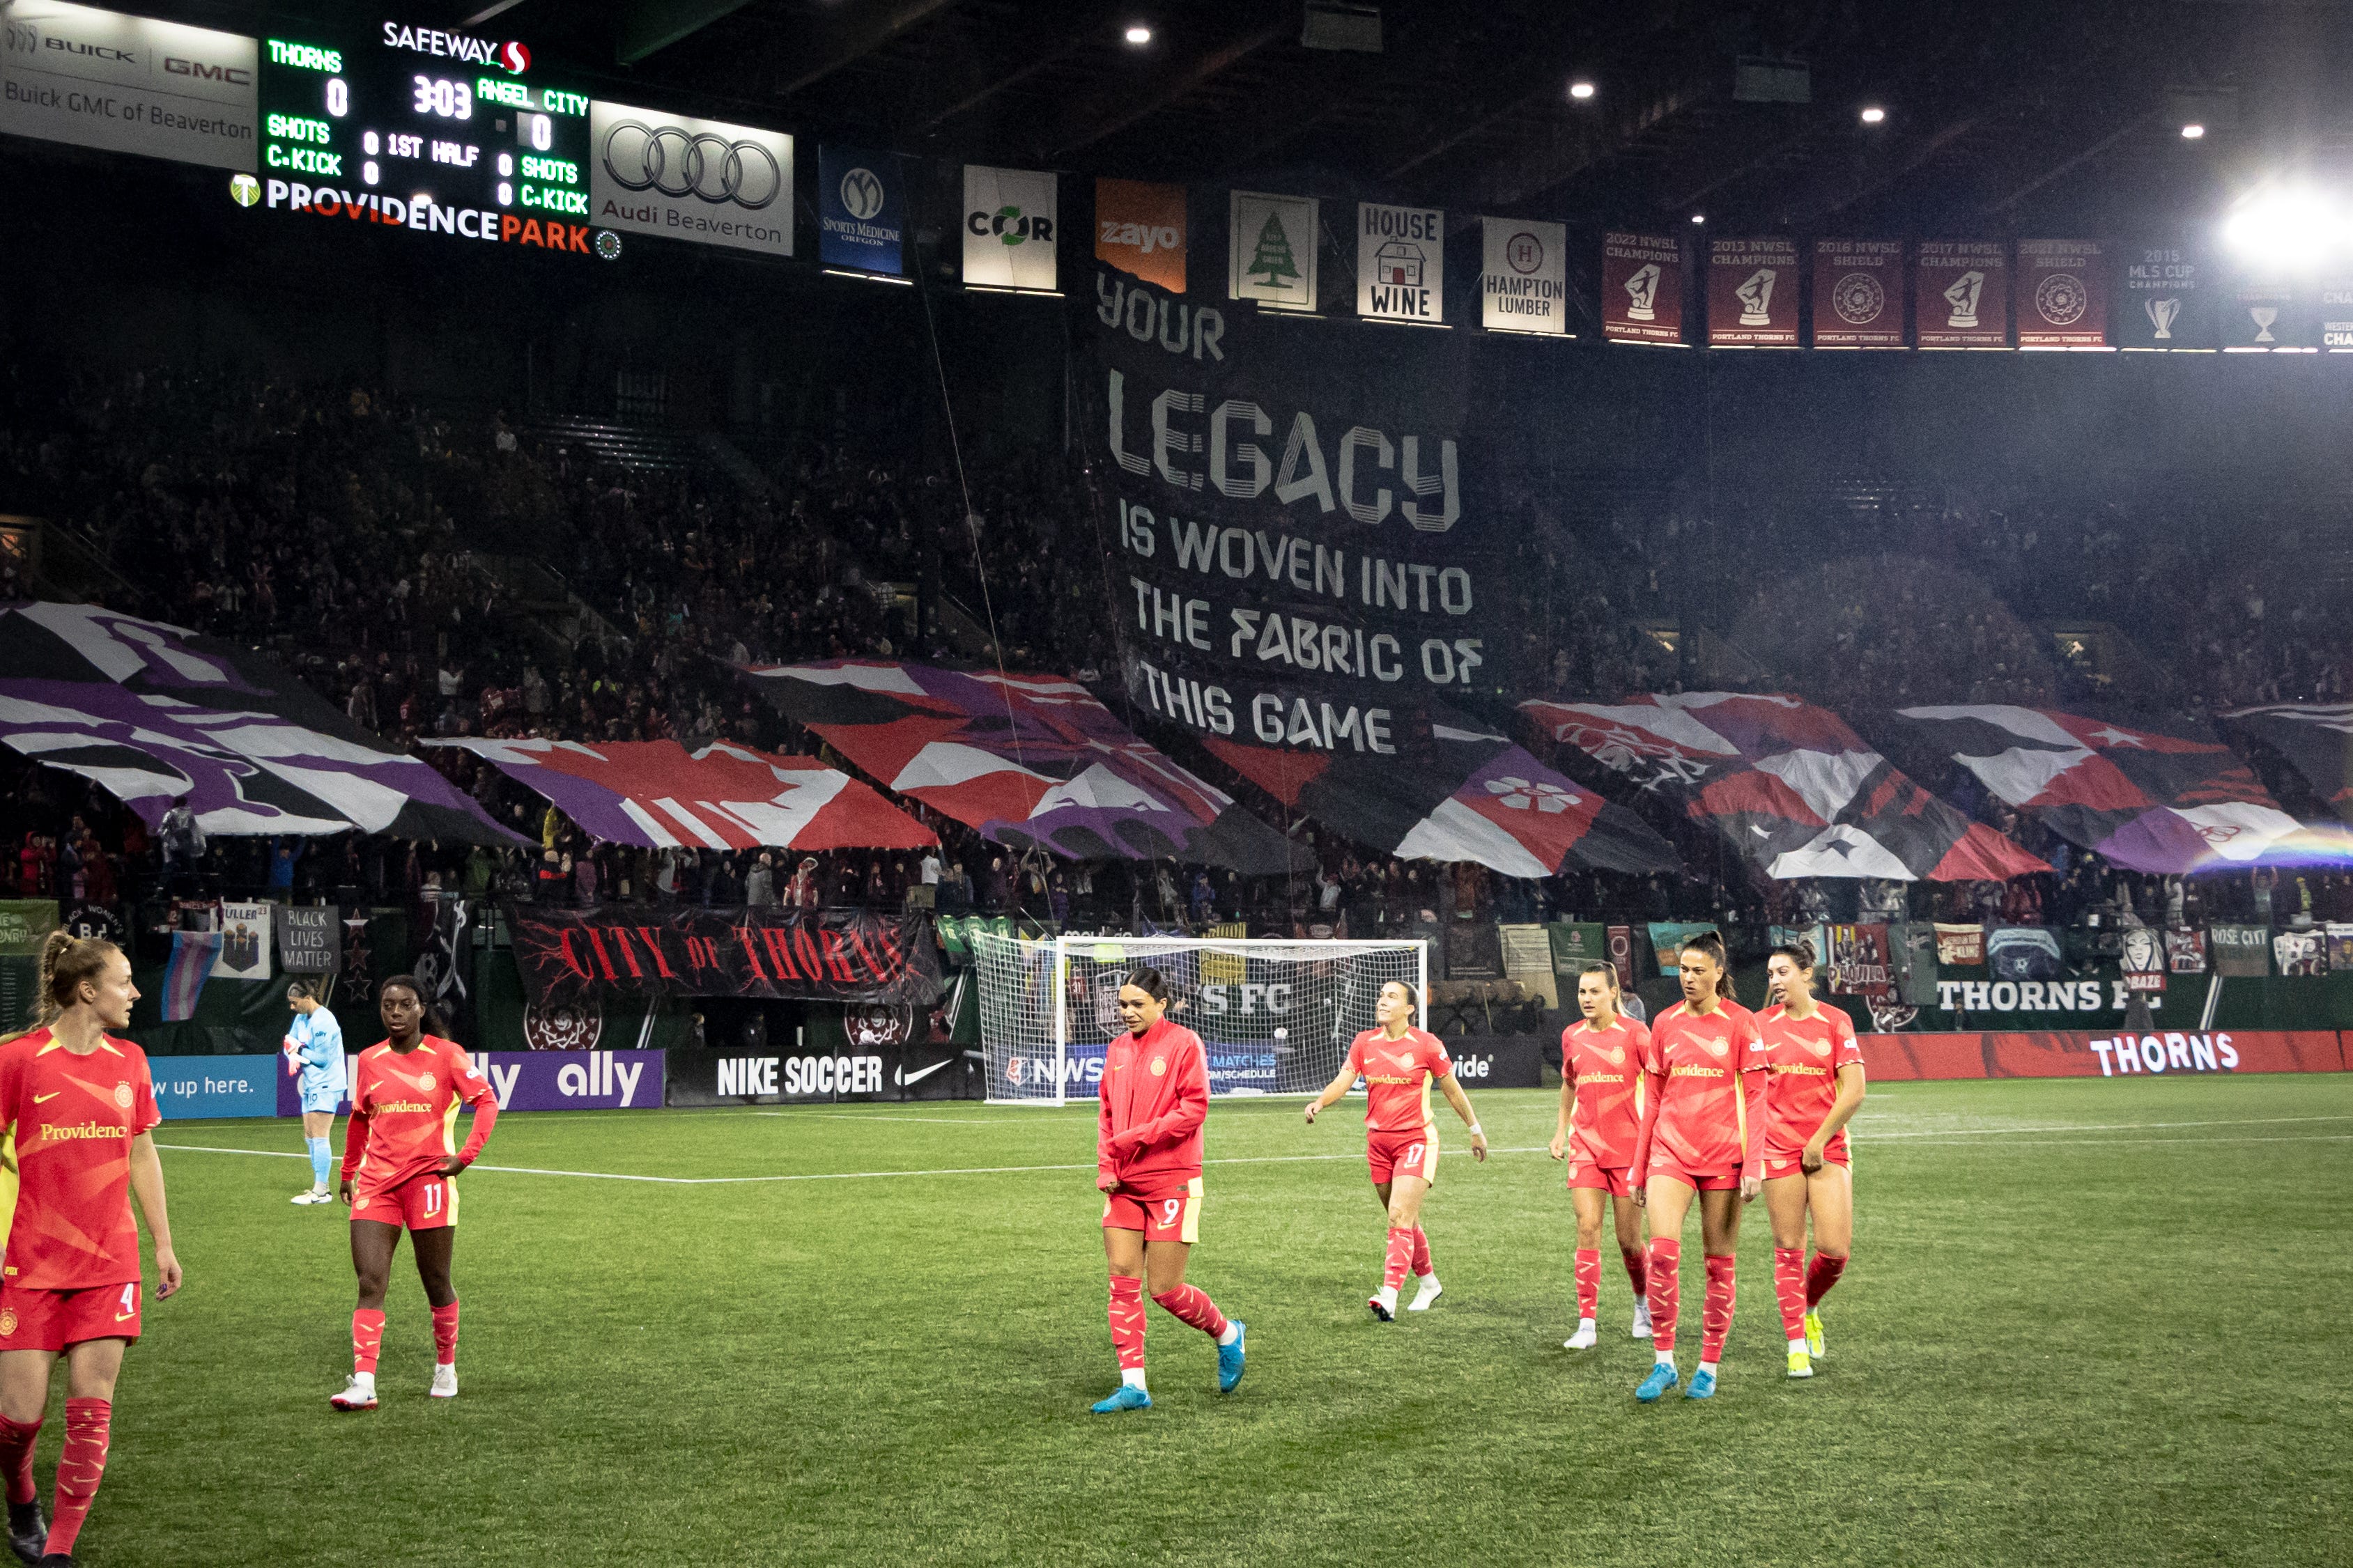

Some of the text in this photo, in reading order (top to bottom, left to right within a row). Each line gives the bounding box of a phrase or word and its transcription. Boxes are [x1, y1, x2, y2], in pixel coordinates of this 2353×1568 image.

[45, 37, 136, 63] BUICK
[384, 22, 497, 63] SAFEWAY
[268, 40, 341, 72] THORNS
[164, 57, 250, 86] GMC
[6, 81, 252, 139] Buick GMC of Beaverton
[327, 79, 348, 116] 0
[414, 75, 472, 120] 3:03
[477, 79, 589, 116] ANGEL CITY
[268, 114, 330, 143] SHOTS
[532, 114, 551, 150] 0
[387, 133, 479, 166] 1ST HALF
[364, 162, 379, 184] 0
[498, 154, 578, 184] 0 SHOTS
[498, 183, 513, 206] 0
[268, 179, 498, 241] PROVIDENCE
[502, 215, 591, 254] PARK
[602, 200, 781, 244] Audi Beaverton
[823, 217, 901, 242] SPORTS MEDICINE
[967, 205, 1053, 246] COR
[1365, 208, 1437, 242] HOUSE
[841, 234, 884, 247] OREGON
[1101, 221, 1180, 254] zayo
[1640, 235, 1679, 250] NWSL
[1750, 241, 1795, 252] NWSL
[1856, 242, 1900, 254] NWSL
[1958, 244, 2002, 255] NWSL
[2058, 244, 2101, 255] NWSL
[1518, 244, 1532, 263] H
[1606, 247, 1679, 263] CHAMPIONS
[1711, 255, 1796, 265] CHAMPIONS
[1833, 256, 1883, 266] SHIELD
[1920, 257, 2003, 267] CHAMPIONS
[2035, 258, 2086, 267] SHIELD
[2129, 265, 2195, 278] MLS CUP
[1486, 275, 1563, 299] HAMPTON
[2129, 281, 2195, 289] CHAMPIONS
[1371, 286, 1430, 316] WINE
[1498, 297, 1550, 317] LUMBER
[1097, 271, 1224, 361] YOUR
[1605, 325, 1641, 334] PORTLAND
[1642, 328, 1668, 337] THORNS
[1109, 368, 1460, 532] LEGACY
[1120, 497, 1472, 614] IS WOVEN INTO
[1130, 575, 1483, 684] THE FABRIC OF
[1141, 660, 1396, 754] THIS GAME
[222, 906, 256, 919] ÜLLER
[288, 910, 327, 927] BLACK
[291, 931, 324, 947] LIVES
[2212, 929, 2267, 945] ROSE CITY
[284, 951, 332, 967] MATTER
[560, 926, 675, 981] CITY
[1240, 984, 1291, 1014] FC
[1936, 981, 2101, 1011] THORNS
[1212, 1053, 1276, 1067] MATCHES
[2090, 1032, 2239, 1076] THORNS
[557, 1051, 643, 1106] ally
[718, 1056, 882, 1096] NIKE SOCCER
[1035, 1057, 1106, 1082] NWS
[1671, 1063, 1724, 1077] rovidence
[1771, 1062, 1827, 1076] Povidence
[174, 1080, 198, 1099] up
[205, 1076, 254, 1094] here.
[1407, 1143, 1424, 1164] 17
[424, 1183, 441, 1211] 11
[1163, 1199, 1180, 1225] 9
[120, 1283, 134, 1312] 4
